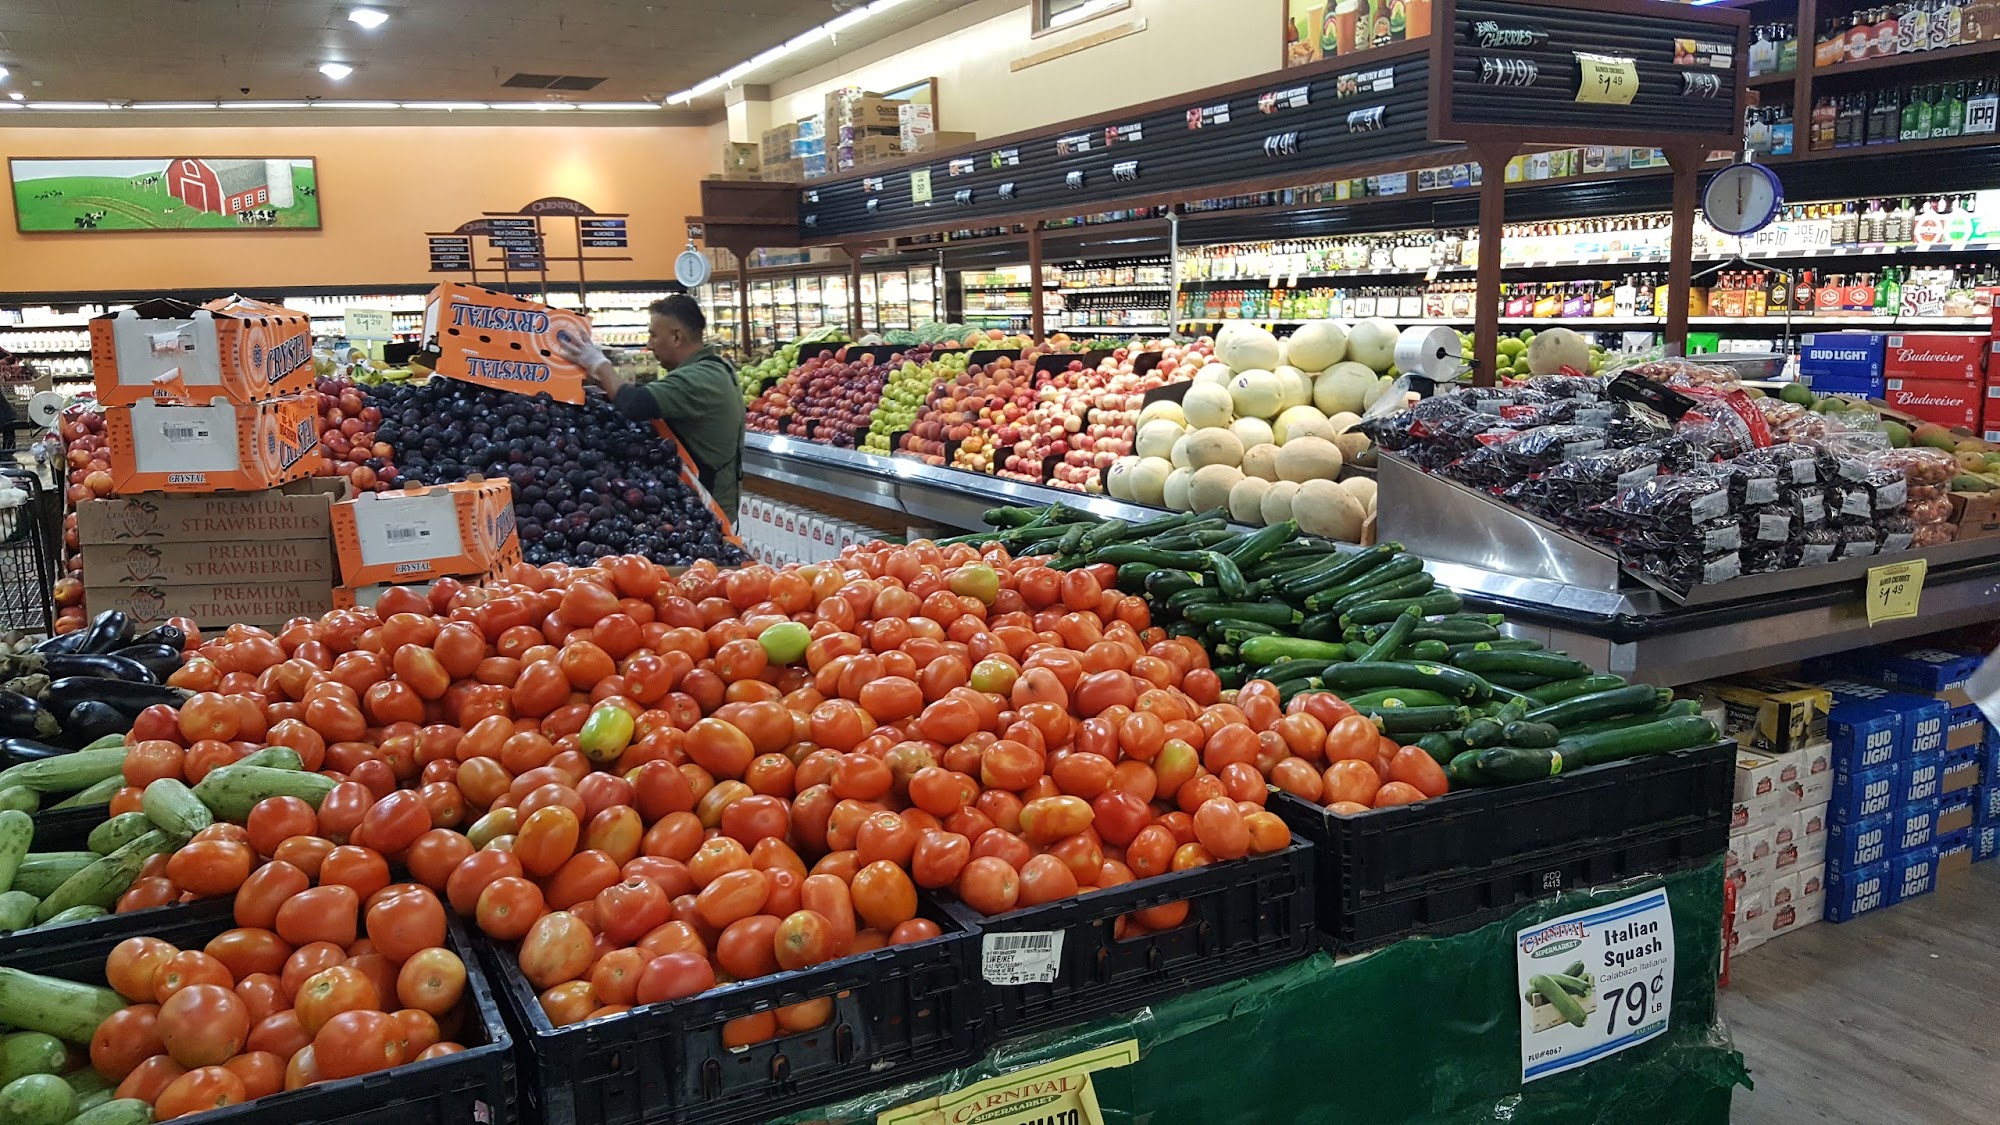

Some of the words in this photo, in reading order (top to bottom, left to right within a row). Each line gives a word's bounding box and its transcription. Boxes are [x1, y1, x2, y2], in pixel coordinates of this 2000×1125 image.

[1476, 21, 1498, 37] BING
[1481, 30, 1533, 48] CHERRIES
[1969, 106, 1994, 126] IPA
[451, 302, 550, 334] CRYSTAL
[1810, 350, 1832, 360] BUD
[1834, 350, 1868, 361] LIGHT
[1896, 349, 1964, 362] Budweiser
[466, 357, 550, 382] CRYSTAL
[1896, 391, 1964, 406] Budweiser
[168, 473, 206, 483] CRYSTAL
[205, 500, 295, 515] PREMIUM
[182, 515, 320, 532] STRAWBERRIES
[209, 544, 297, 559] PREMIUM
[185, 559, 323, 576] STRAWBERRIES
[394, 561, 431, 574] CRYSTAL
[212, 585, 300, 600] PREMIUM
[189, 600, 326, 617] STRAWBERRIES
[1916, 718, 1940, 737] BUD
[1866, 730, 1892, 750] BUD
[1912, 733, 1942, 753] LIGHT
[1862, 745, 1893, 766] LIGHT
[1912, 765, 1935, 785] BUD
[1865, 780, 1889, 800] BUD
[1908, 780, 1936, 800] LIGHT
[1860, 794, 1890, 816] LIGHT
[1906, 814, 1930, 834] BUD
[1857, 829, 1882, 850] BUD
[1901, 828, 1931, 849] LIGHT
[1853, 843, 1884, 865] LIGHT
[1905, 862, 1929, 882] BUD
[1856, 878, 1880, 898] BUD
[1900, 876, 1930, 897] LIGHT
[1851, 892, 1882, 914] LIGHT
[1522, 922, 1591, 954] CARNIVAL
[1604, 921, 1658, 946] Italian
[1534, 940, 1578, 958] SUPERMARKET
[1604, 937, 1662, 968] Squash
[1600, 967, 1637, 983] Calabaza
[1639, 957, 1668, 971] Italiana
[1651, 1003, 1662, 1014] LB
[953, 1076, 1078, 1124] CARNIVAL
[974, 1095, 1054, 1124] SUPERMARKET
